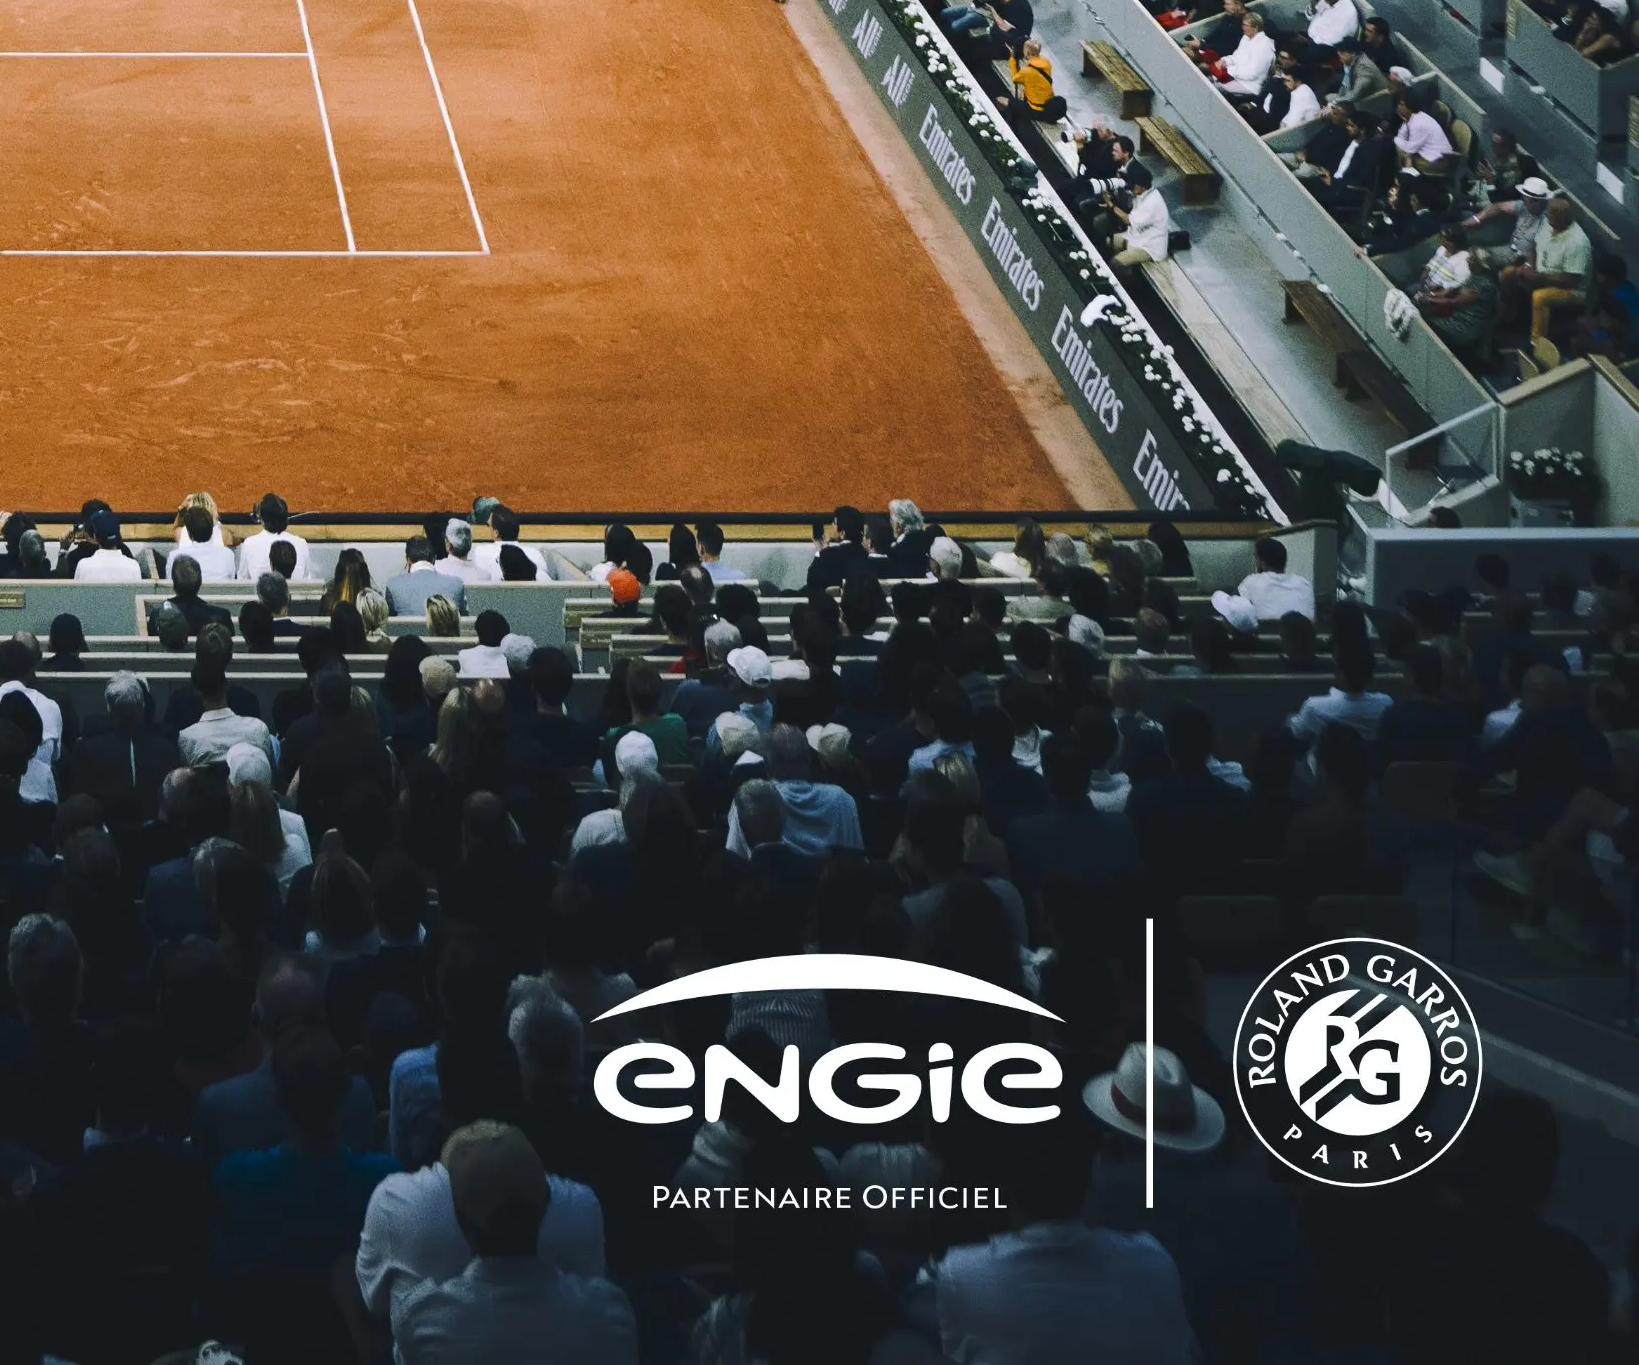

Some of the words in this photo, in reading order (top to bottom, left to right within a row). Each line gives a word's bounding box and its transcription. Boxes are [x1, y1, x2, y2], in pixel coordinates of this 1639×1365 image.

[918, 103, 976, 206] Emirates
[980, 196, 1045, 312] Emirates
[1051, 304, 1125, 434] Emirates
